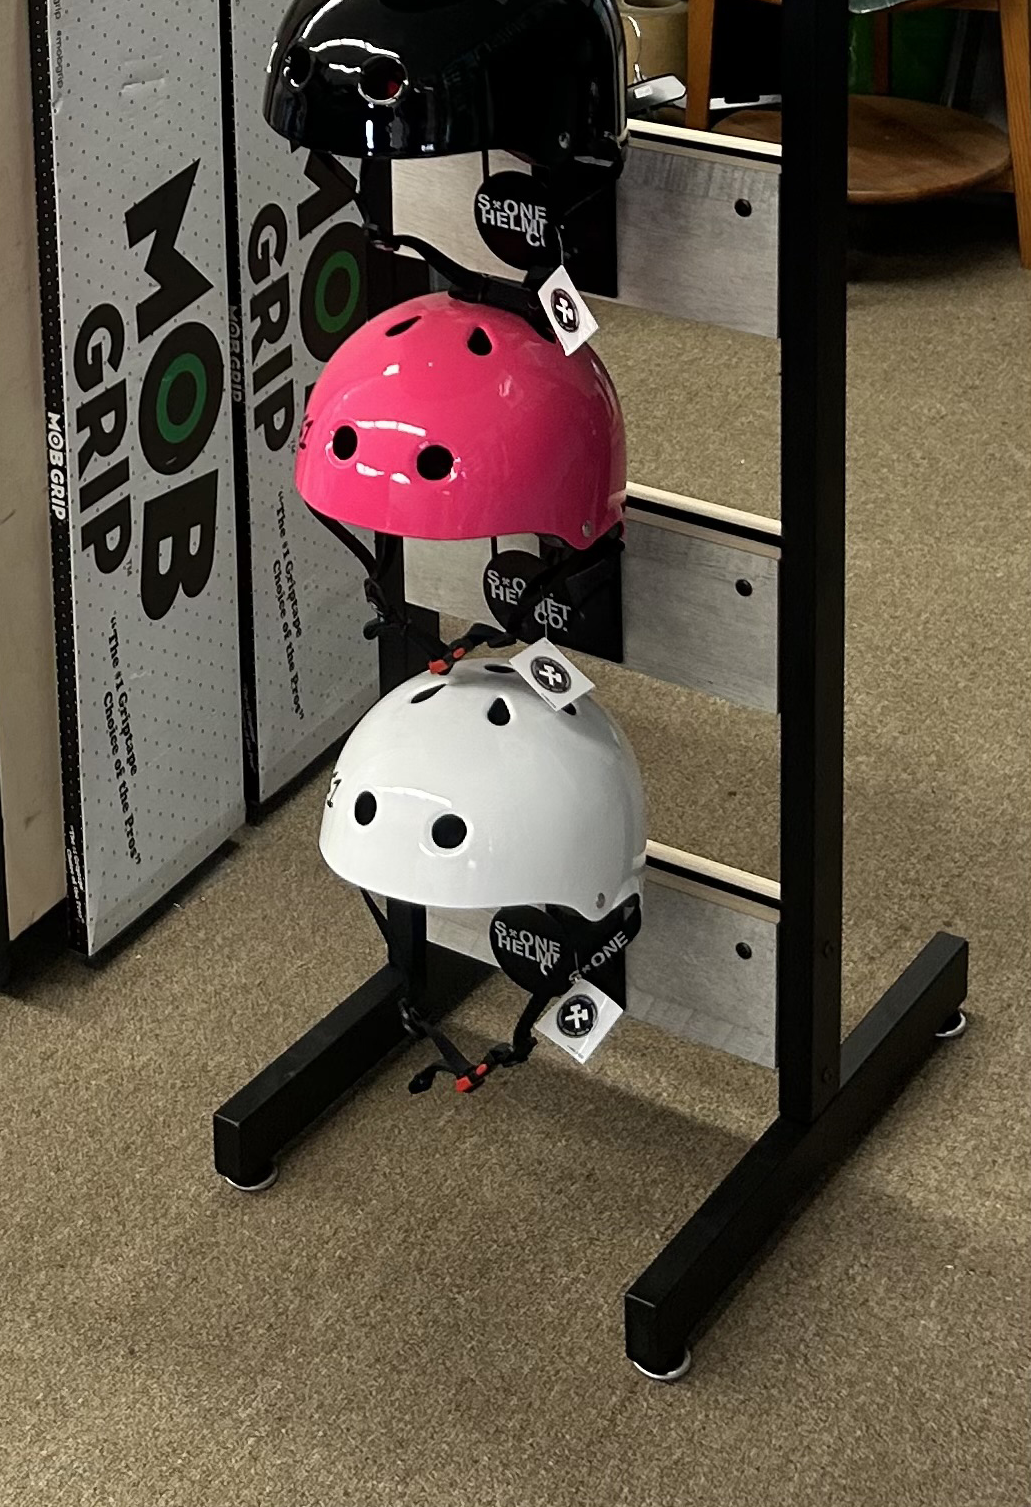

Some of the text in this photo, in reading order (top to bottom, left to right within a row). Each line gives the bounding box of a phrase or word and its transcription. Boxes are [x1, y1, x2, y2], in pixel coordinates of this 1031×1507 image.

[248, 202, 296, 452] GRIP
[124, 157, 225, 621] MOB
[47, 411, 67, 521] MOB GRIP
[73, 303, 132, 575] GRIP
[272, 559, 287, 620] Choice
[284, 559, 302, 639] Griptape
[282, 621, 292, 642] of
[285, 642, 295, 674] the
[103, 691, 119, 756] Choice
[118, 691, 137, 777] Griptape
[114, 757, 124, 779] of
[118, 779, 130, 813] the
[590, 930, 629, 968] ONE
